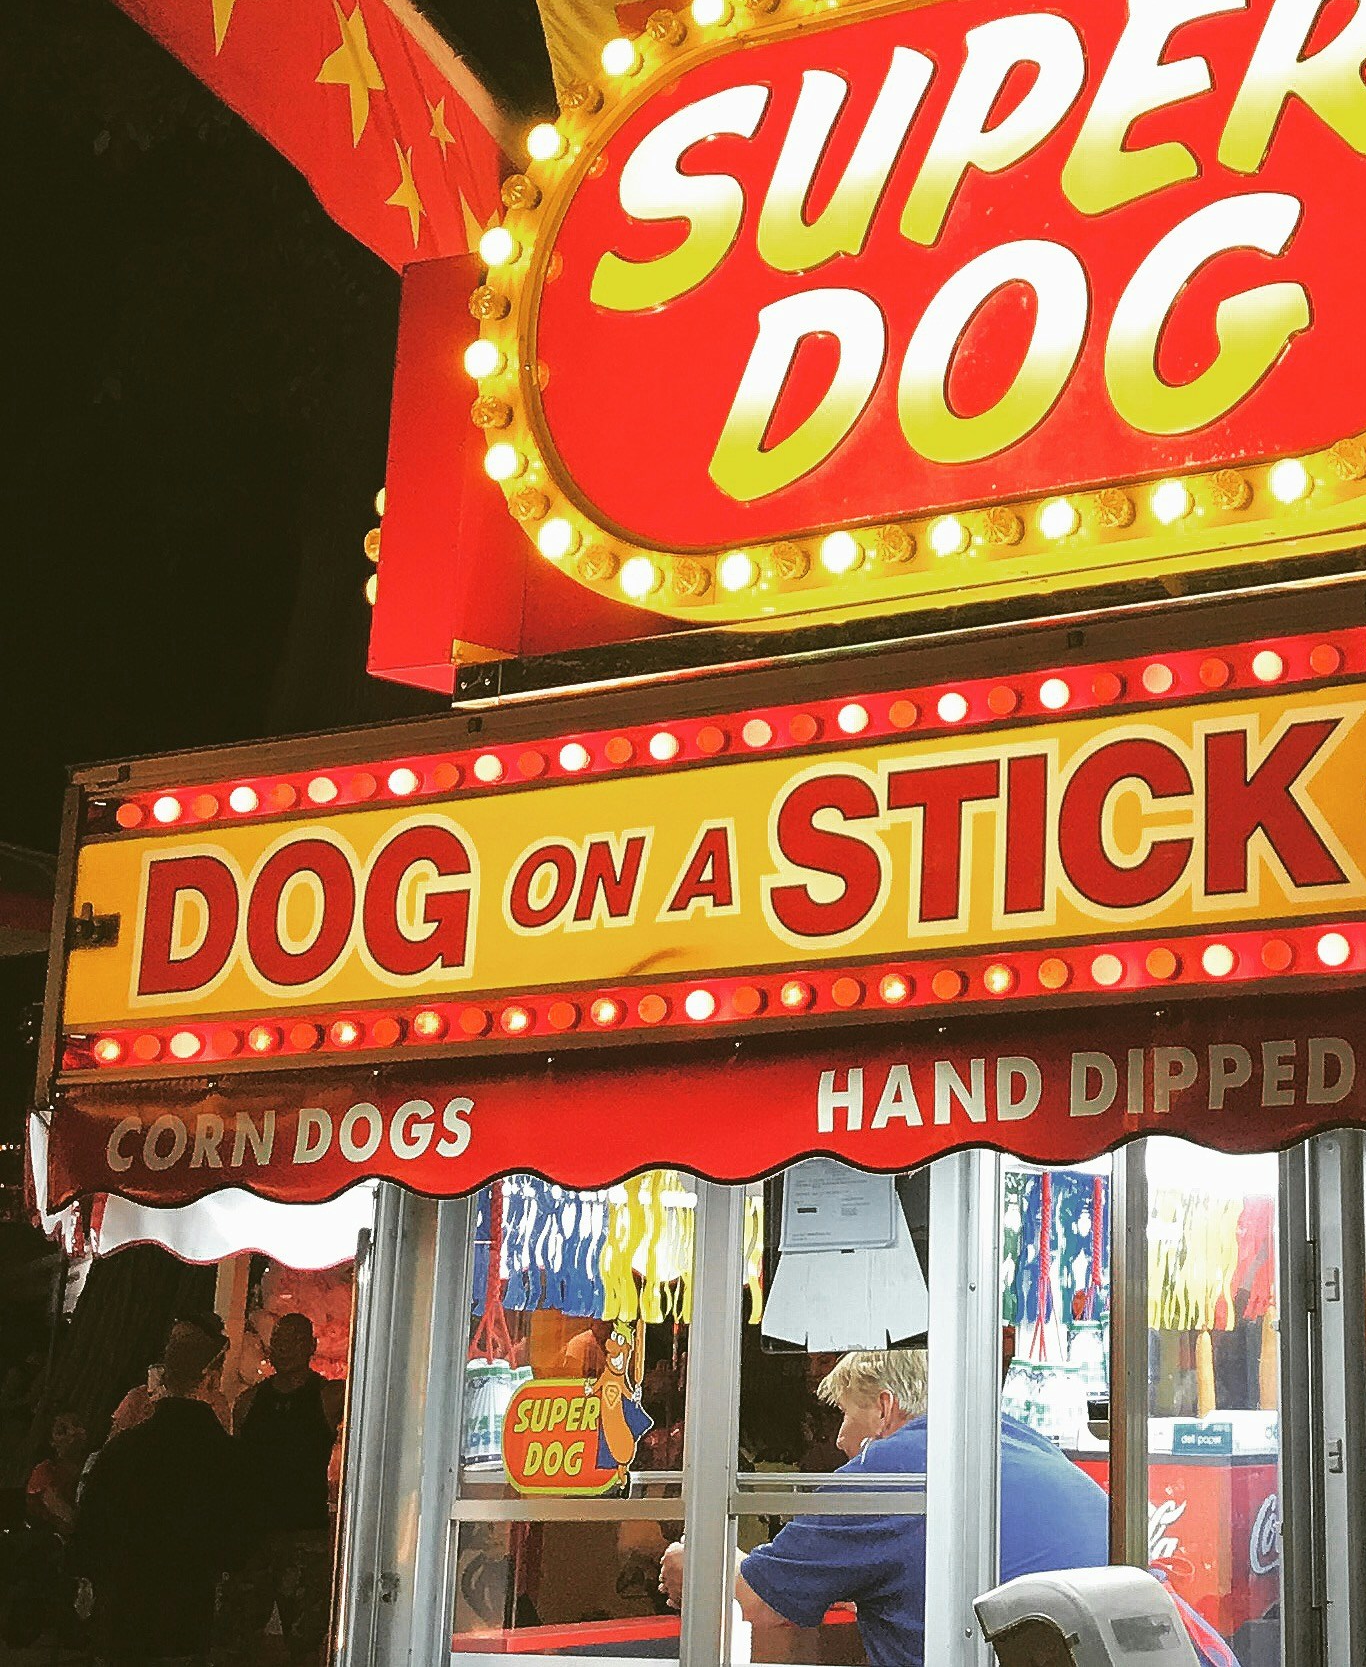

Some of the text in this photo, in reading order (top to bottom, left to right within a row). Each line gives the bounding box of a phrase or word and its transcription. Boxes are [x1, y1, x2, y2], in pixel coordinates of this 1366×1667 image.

[708, 191, 1313, 503] DOG
[135, 717, 1353, 997] DOG ON A STICK
[816, 1036, 1357, 1134] HAND DIPPED
[105, 1095, 477, 1173] CORN DOGS
[513, 1396, 600, 1433] SUPER
[522, 1441, 586, 1477] DOG
